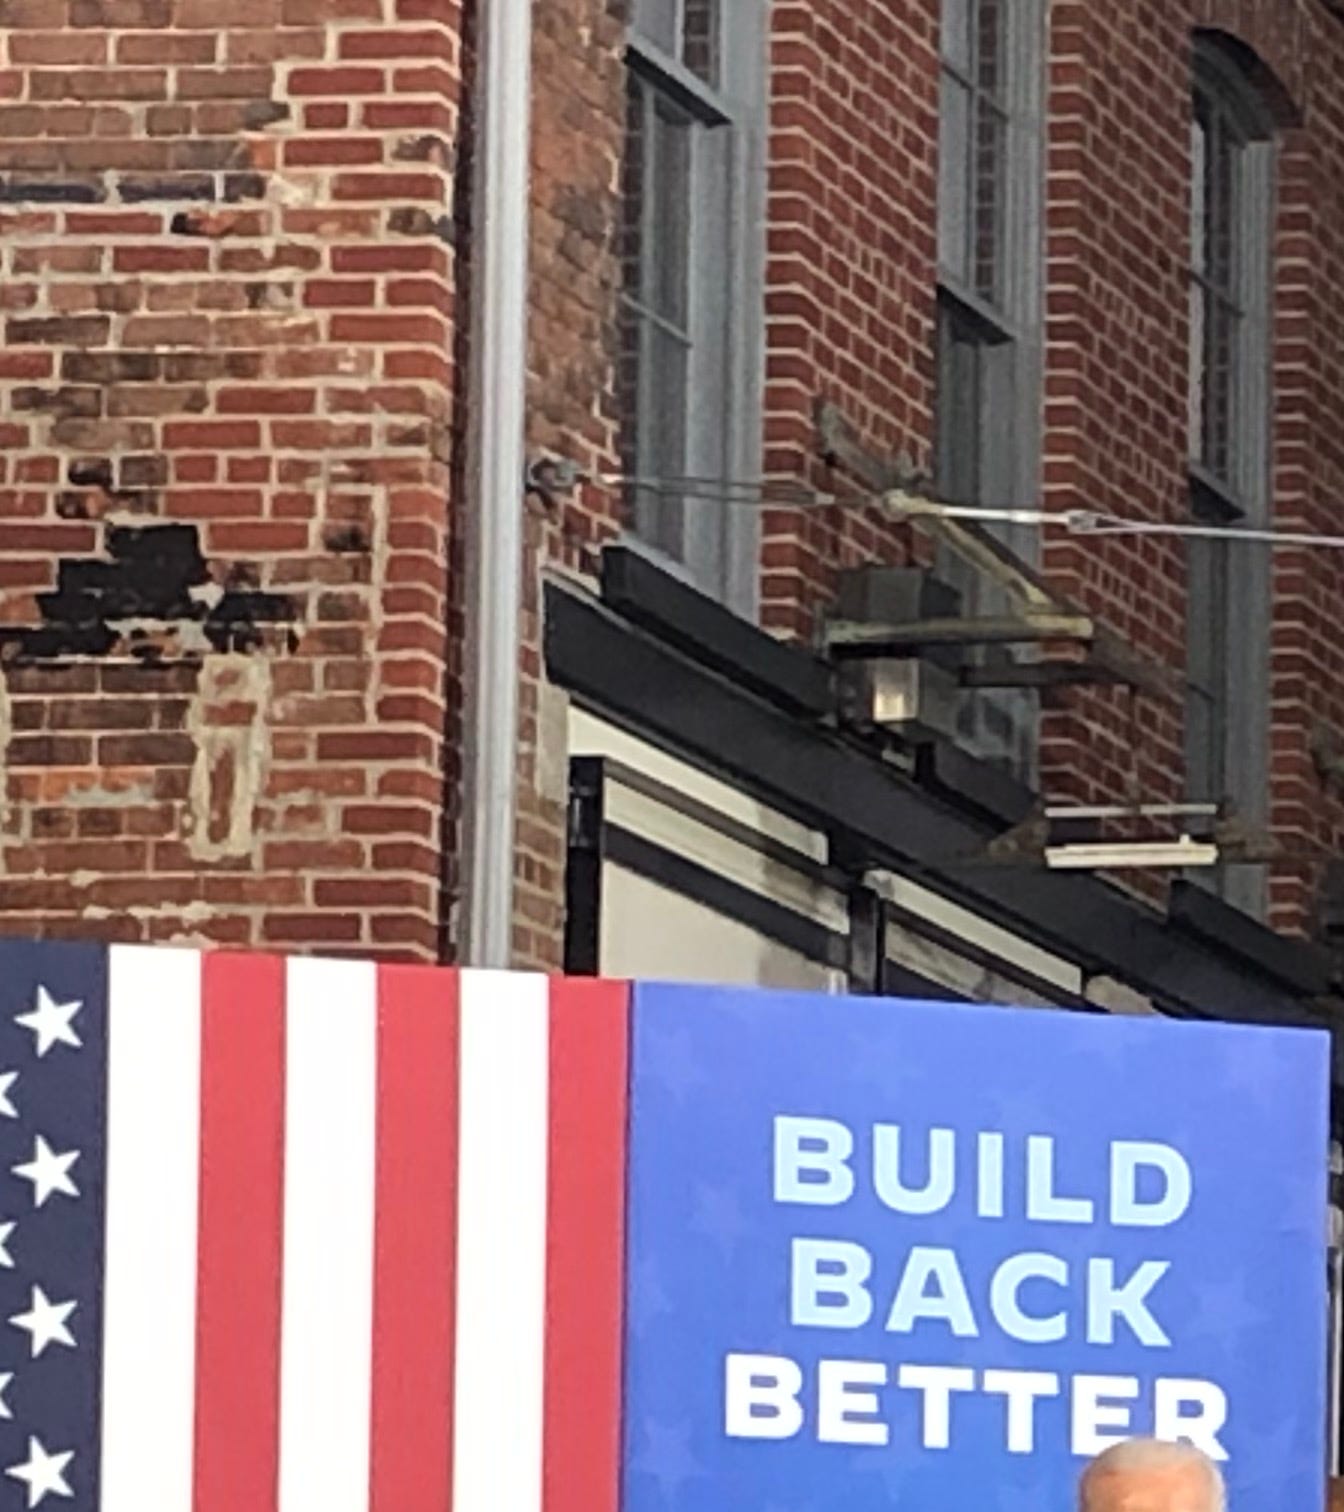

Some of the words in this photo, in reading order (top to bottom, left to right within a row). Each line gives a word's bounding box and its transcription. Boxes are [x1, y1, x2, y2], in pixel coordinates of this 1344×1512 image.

[773, 1115, 1192, 1227] BUILD
[790, 1237, 1171, 1346] BACK
[724, 1353, 1229, 1461] BETTER
